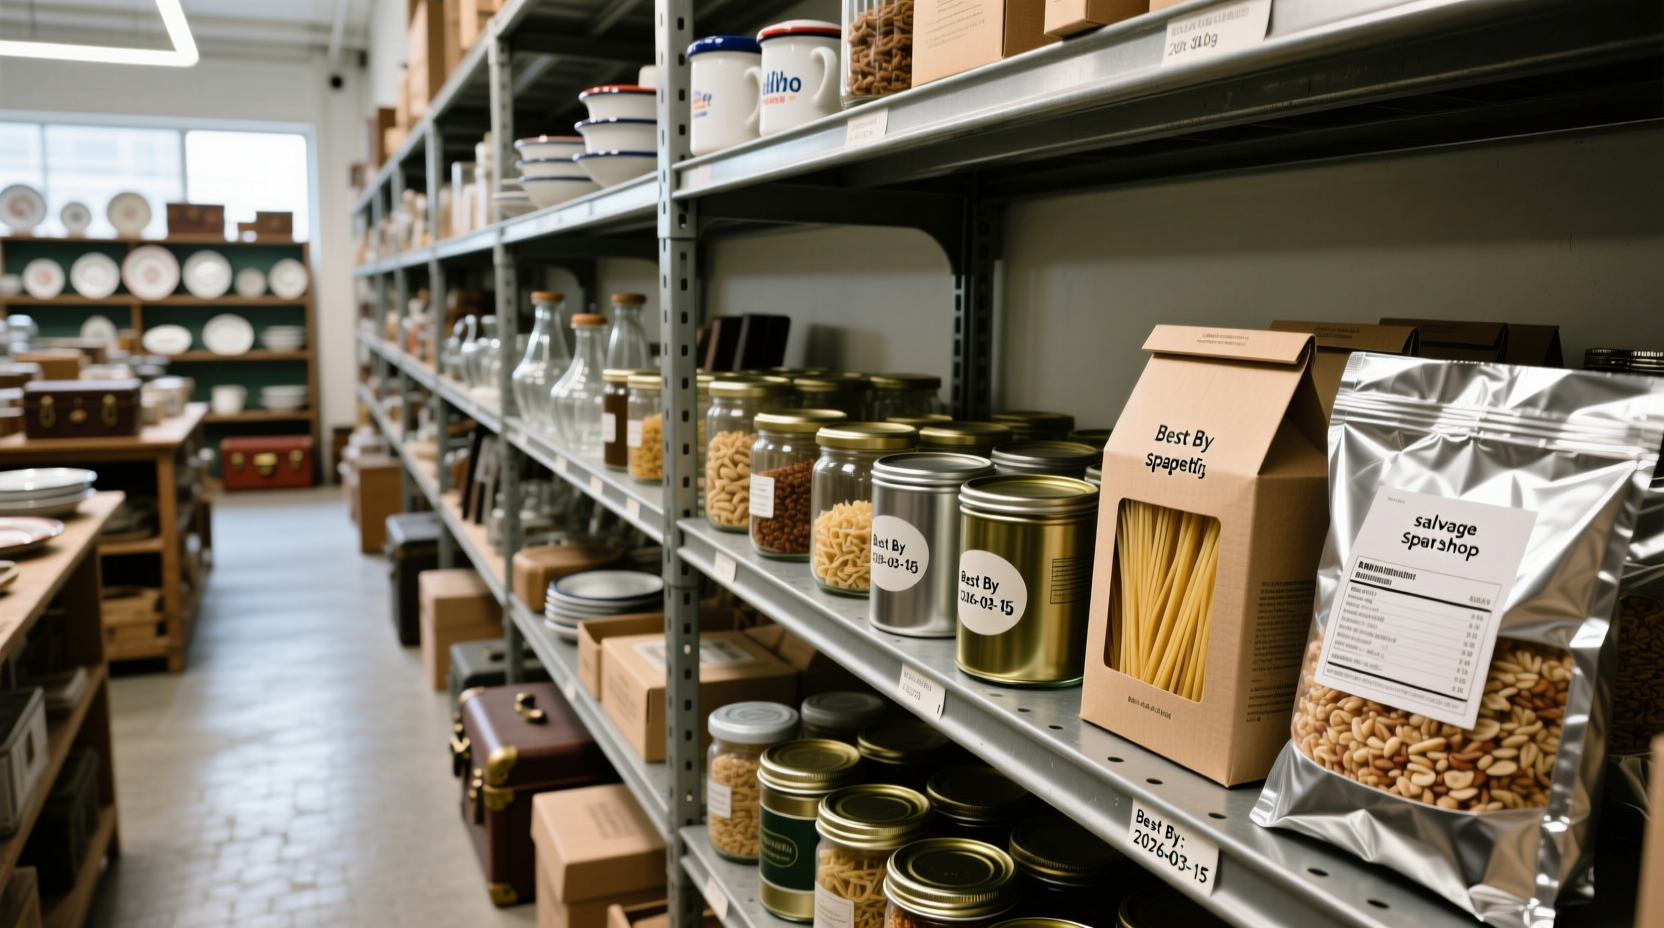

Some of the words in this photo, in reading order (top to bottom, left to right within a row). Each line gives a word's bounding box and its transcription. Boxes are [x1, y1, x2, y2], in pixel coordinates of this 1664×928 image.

[1154, 424, 1191, 446] Best
[1192, 429, 1215, 453] By
[1413, 514, 1478, 539] salvage
[891, 538, 906, 556] By
[983, 575, 1000, 595] By
[1135, 808, 1162, 834] Best
[1165, 825, 1186, 848] By:
[1133, 829, 1209, 883] 2026-03-15
